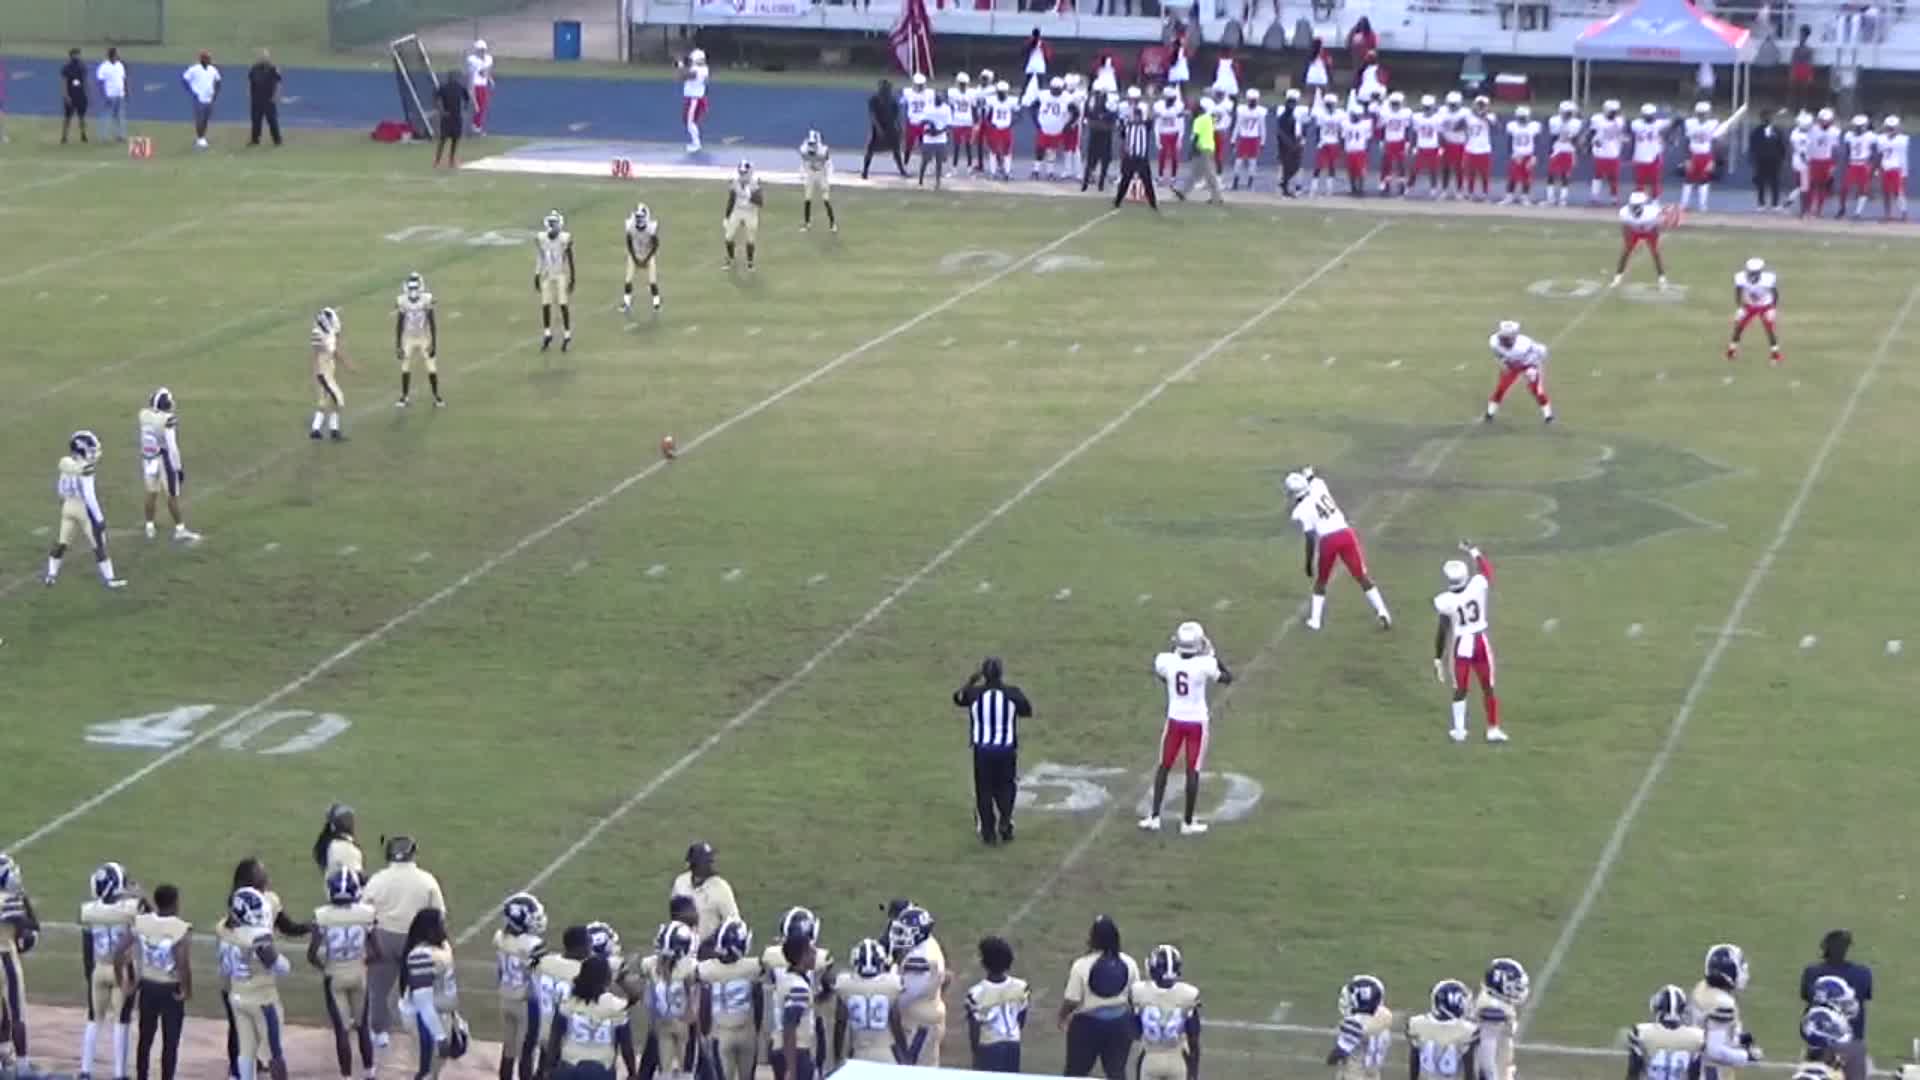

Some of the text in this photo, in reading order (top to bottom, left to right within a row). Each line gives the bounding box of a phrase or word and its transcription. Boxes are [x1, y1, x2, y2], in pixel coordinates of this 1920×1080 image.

[611, 157, 632, 178] 30
[1315, 494, 1337, 520] 40
[1456, 599, 1480, 626] 13
[1175, 671, 1189, 696] 6
[83, 704, 352, 755] 40
[1013, 761, 1264, 823] 50
